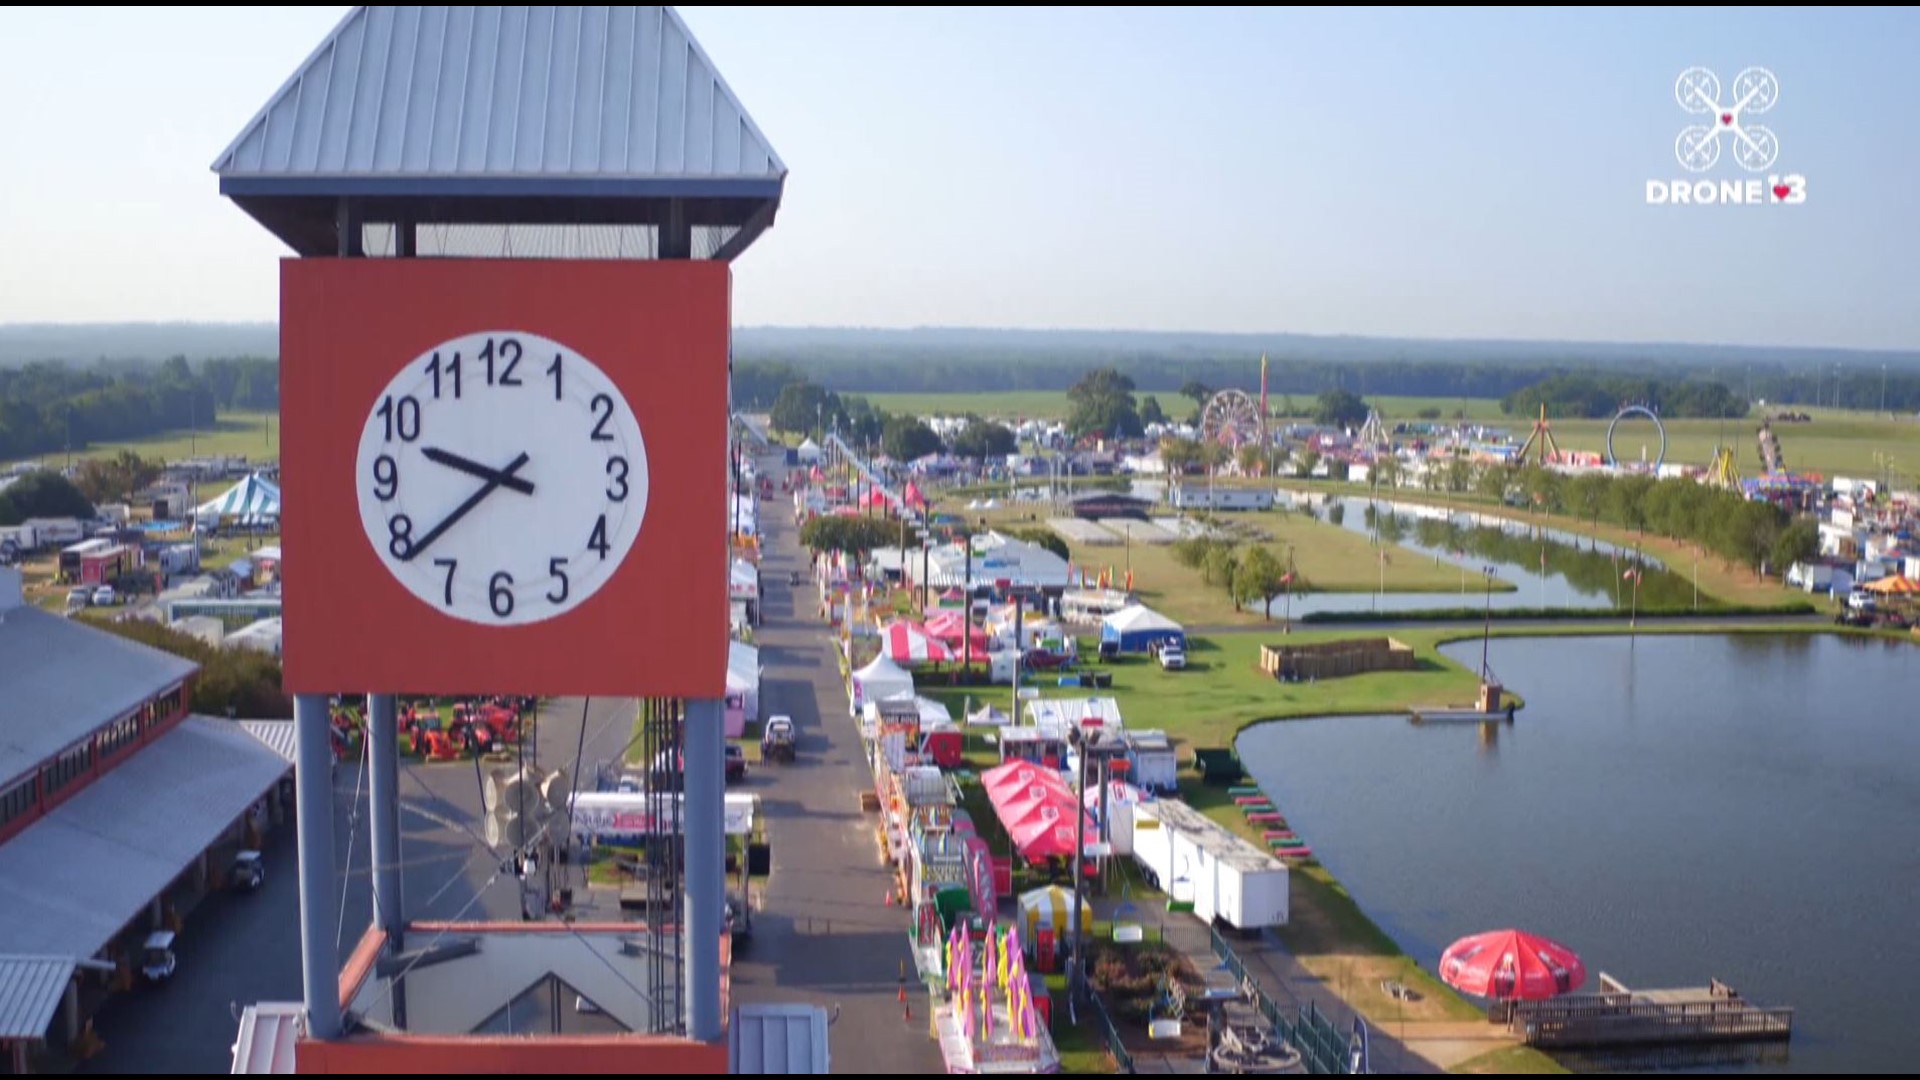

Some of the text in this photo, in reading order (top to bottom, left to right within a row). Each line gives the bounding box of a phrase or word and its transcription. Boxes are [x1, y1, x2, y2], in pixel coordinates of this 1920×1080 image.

[424, 351, 461, 399] 11
[478, 338, 523, 386] 12
[546, 353, 562, 401] 1
[376, 395, 421, 443] 10
[590, 393, 614, 442] 2
[373, 454, 399, 502] 9
[605, 455, 629, 503] 3
[388, 513, 413, 562] 8
[586, 513, 611, 561] 4
[433, 558, 458, 606] 7
[488, 571, 515, 618] 6
[546, 557, 569, 605] 5
